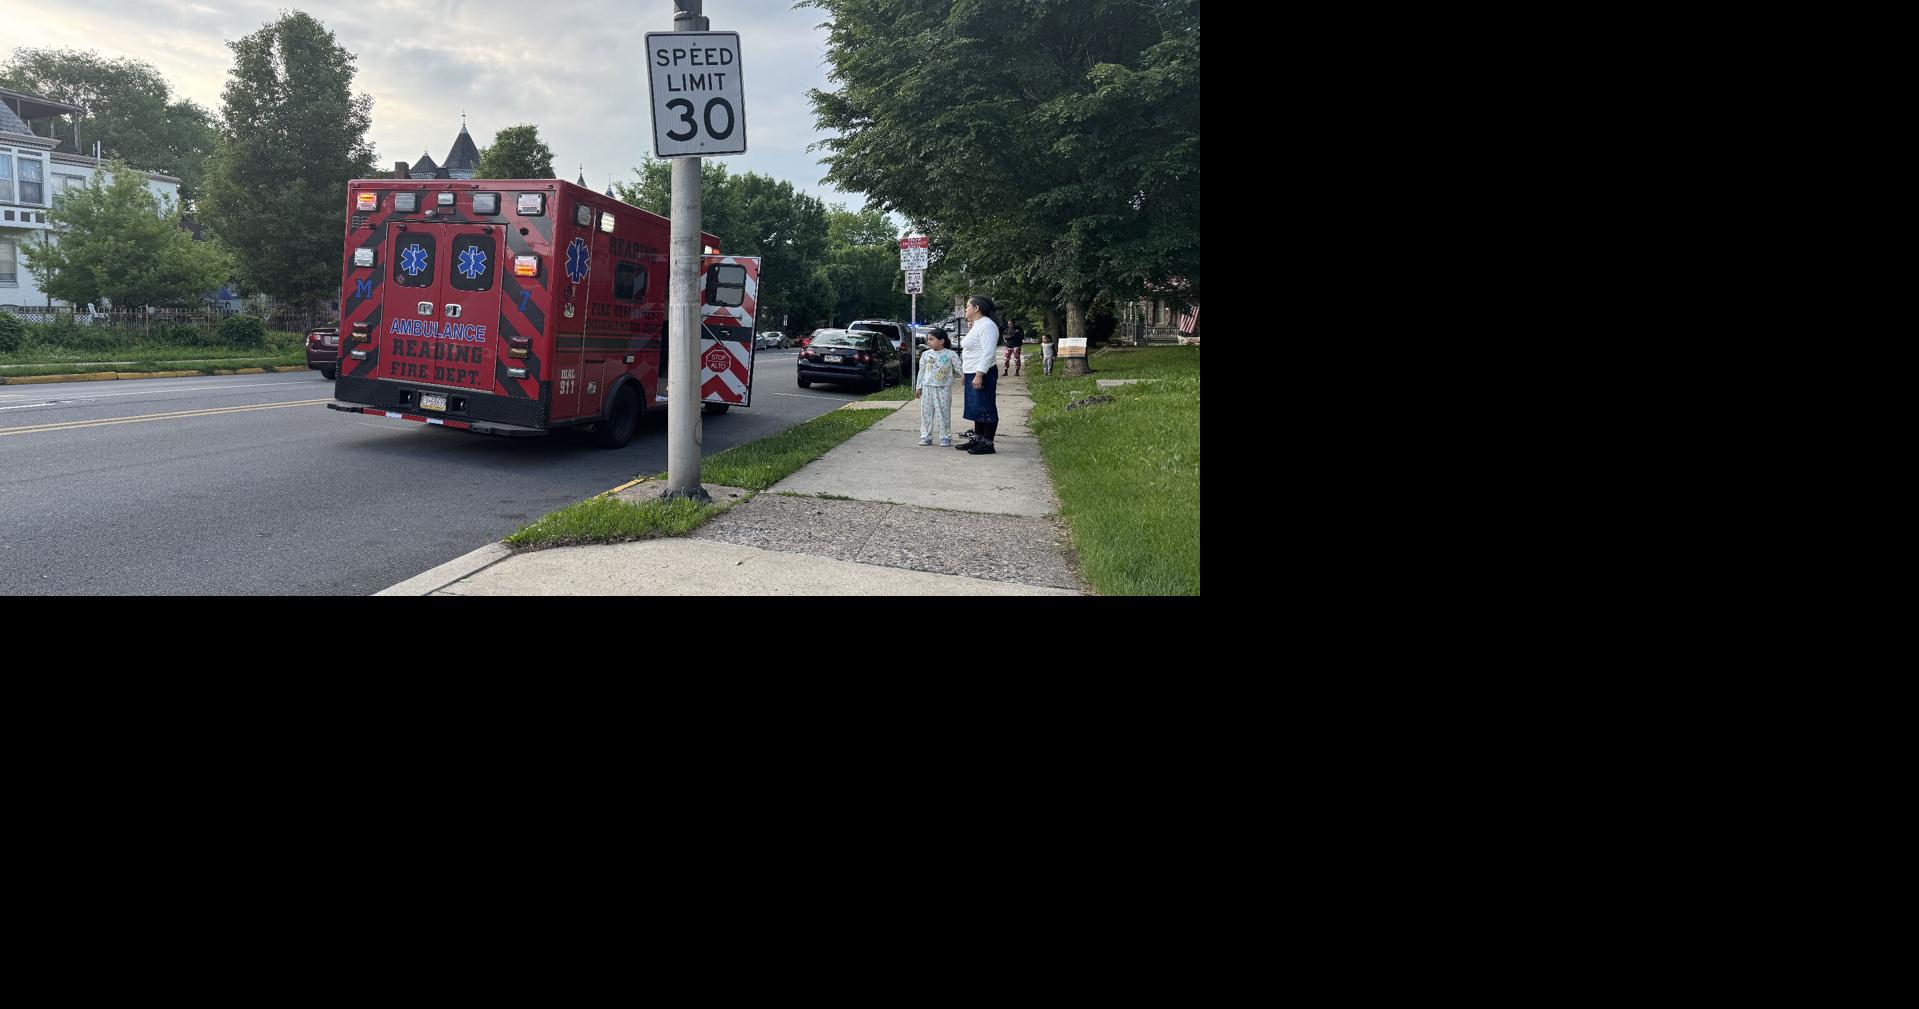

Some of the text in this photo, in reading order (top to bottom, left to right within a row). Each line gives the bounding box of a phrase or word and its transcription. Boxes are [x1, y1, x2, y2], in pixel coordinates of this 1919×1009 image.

[656, 48, 733, 67] SPEED
[667, 72, 726, 92] LIMIT
[665, 96, 735, 142] 30
[356, 279, 373, 299] M
[517, 290, 531, 312] 7
[390, 317, 486, 343] AMBULANCE
[392, 338, 483, 364] READING
[390, 361, 481, 386] FIRE DEPT.
[560, 368, 576, 380] DIAL
[710, 362, 726, 370] ALTO
[559, 380, 575, 395] 911
